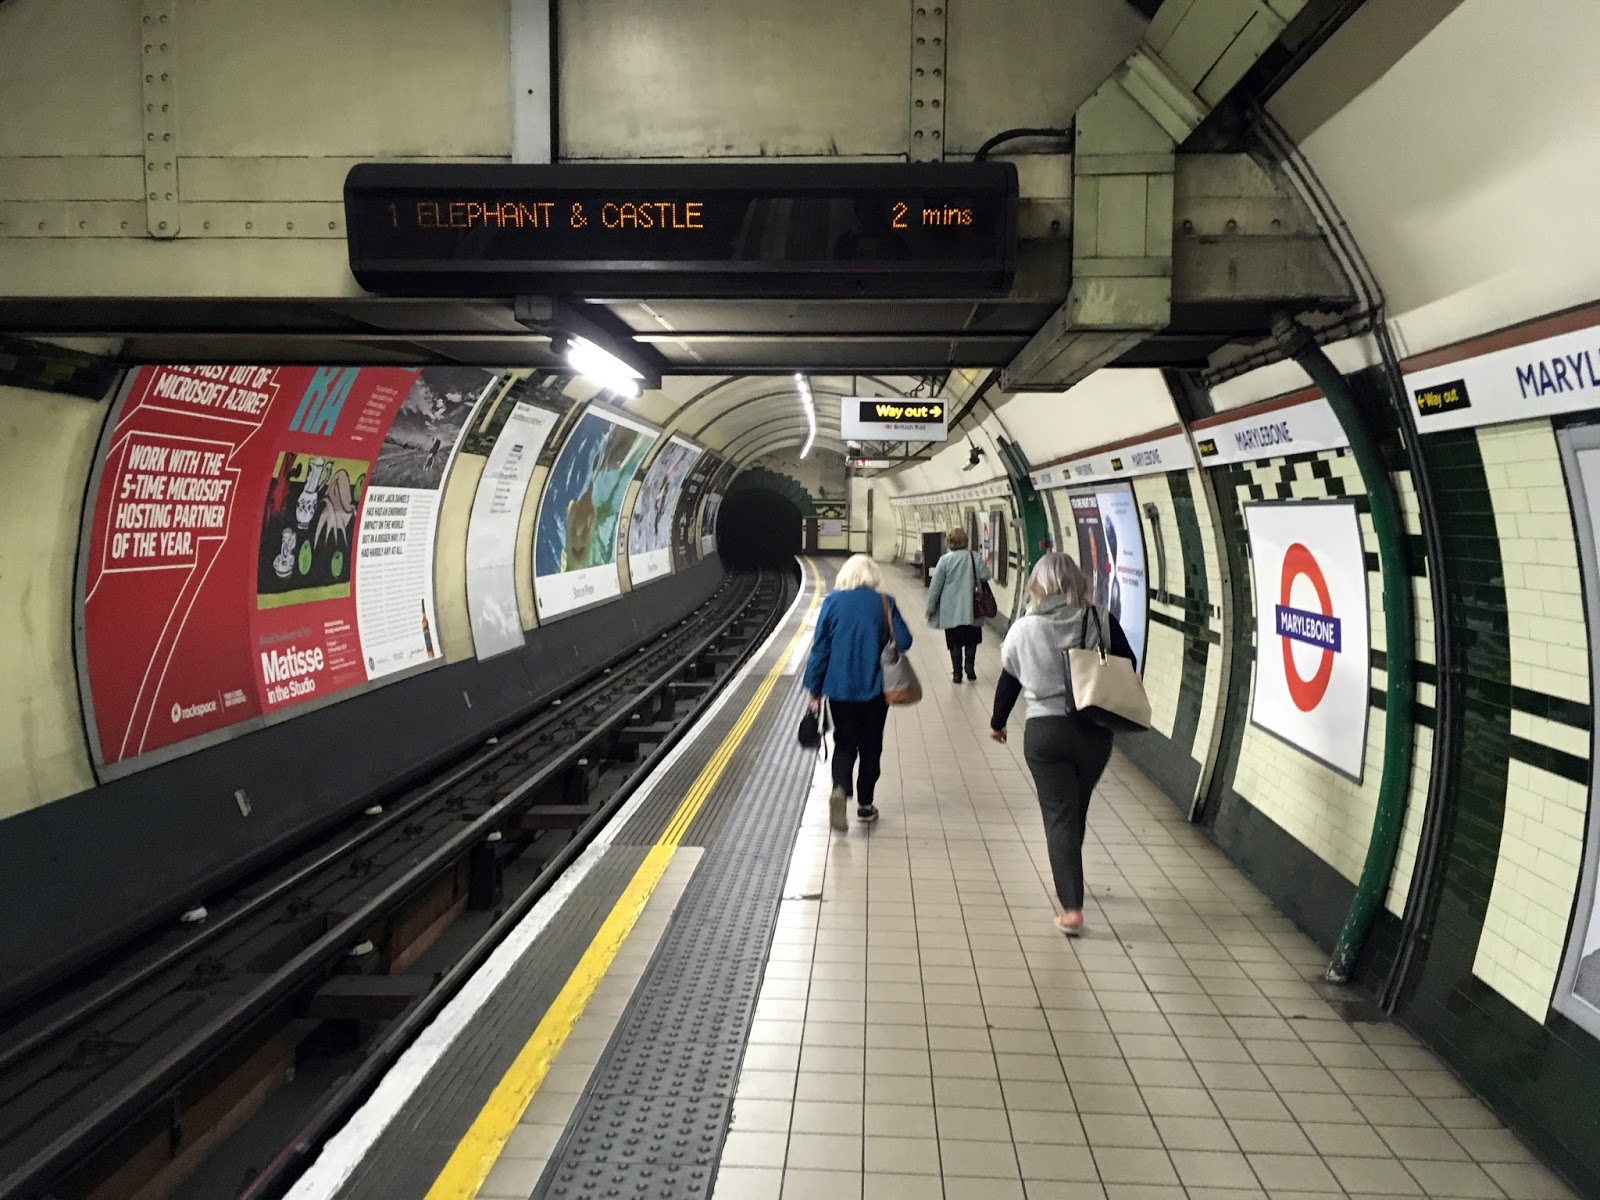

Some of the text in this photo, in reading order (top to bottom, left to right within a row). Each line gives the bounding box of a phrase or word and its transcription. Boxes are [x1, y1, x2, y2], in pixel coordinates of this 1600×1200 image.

[416, 202, 555, 228] ELEPHANT
[570, 202, 588, 228] &
[602, 202, 704, 228] CASTLE
[892, 202, 908, 228] 2
[922, 204, 972, 225] mins
[251, 367, 272, 389] OF
[1515, 347, 1600, 400] MARYL
[153, 372, 269, 415] MICROSOFT AZURE?
[1423, 391, 1442, 408] Way
[876, 404, 928, 419] Way out
[1234, 421, 1293, 451] MARYLEBONE
[128, 444, 226, 476] WORK WITH THE
[120, 473, 232, 502] 5-TIME MICROSOFT
[115, 503, 226, 529] HOSTING PARTNER
[112, 531, 194, 559] OF THE YEAR.
[1280, 611, 1335, 645] MARYLEBONE
[260, 645, 325, 685] Matisse
[266, 688, 277, 704] in
[274, 685, 290, 702] the
[288, 677, 316, 698] Studio
